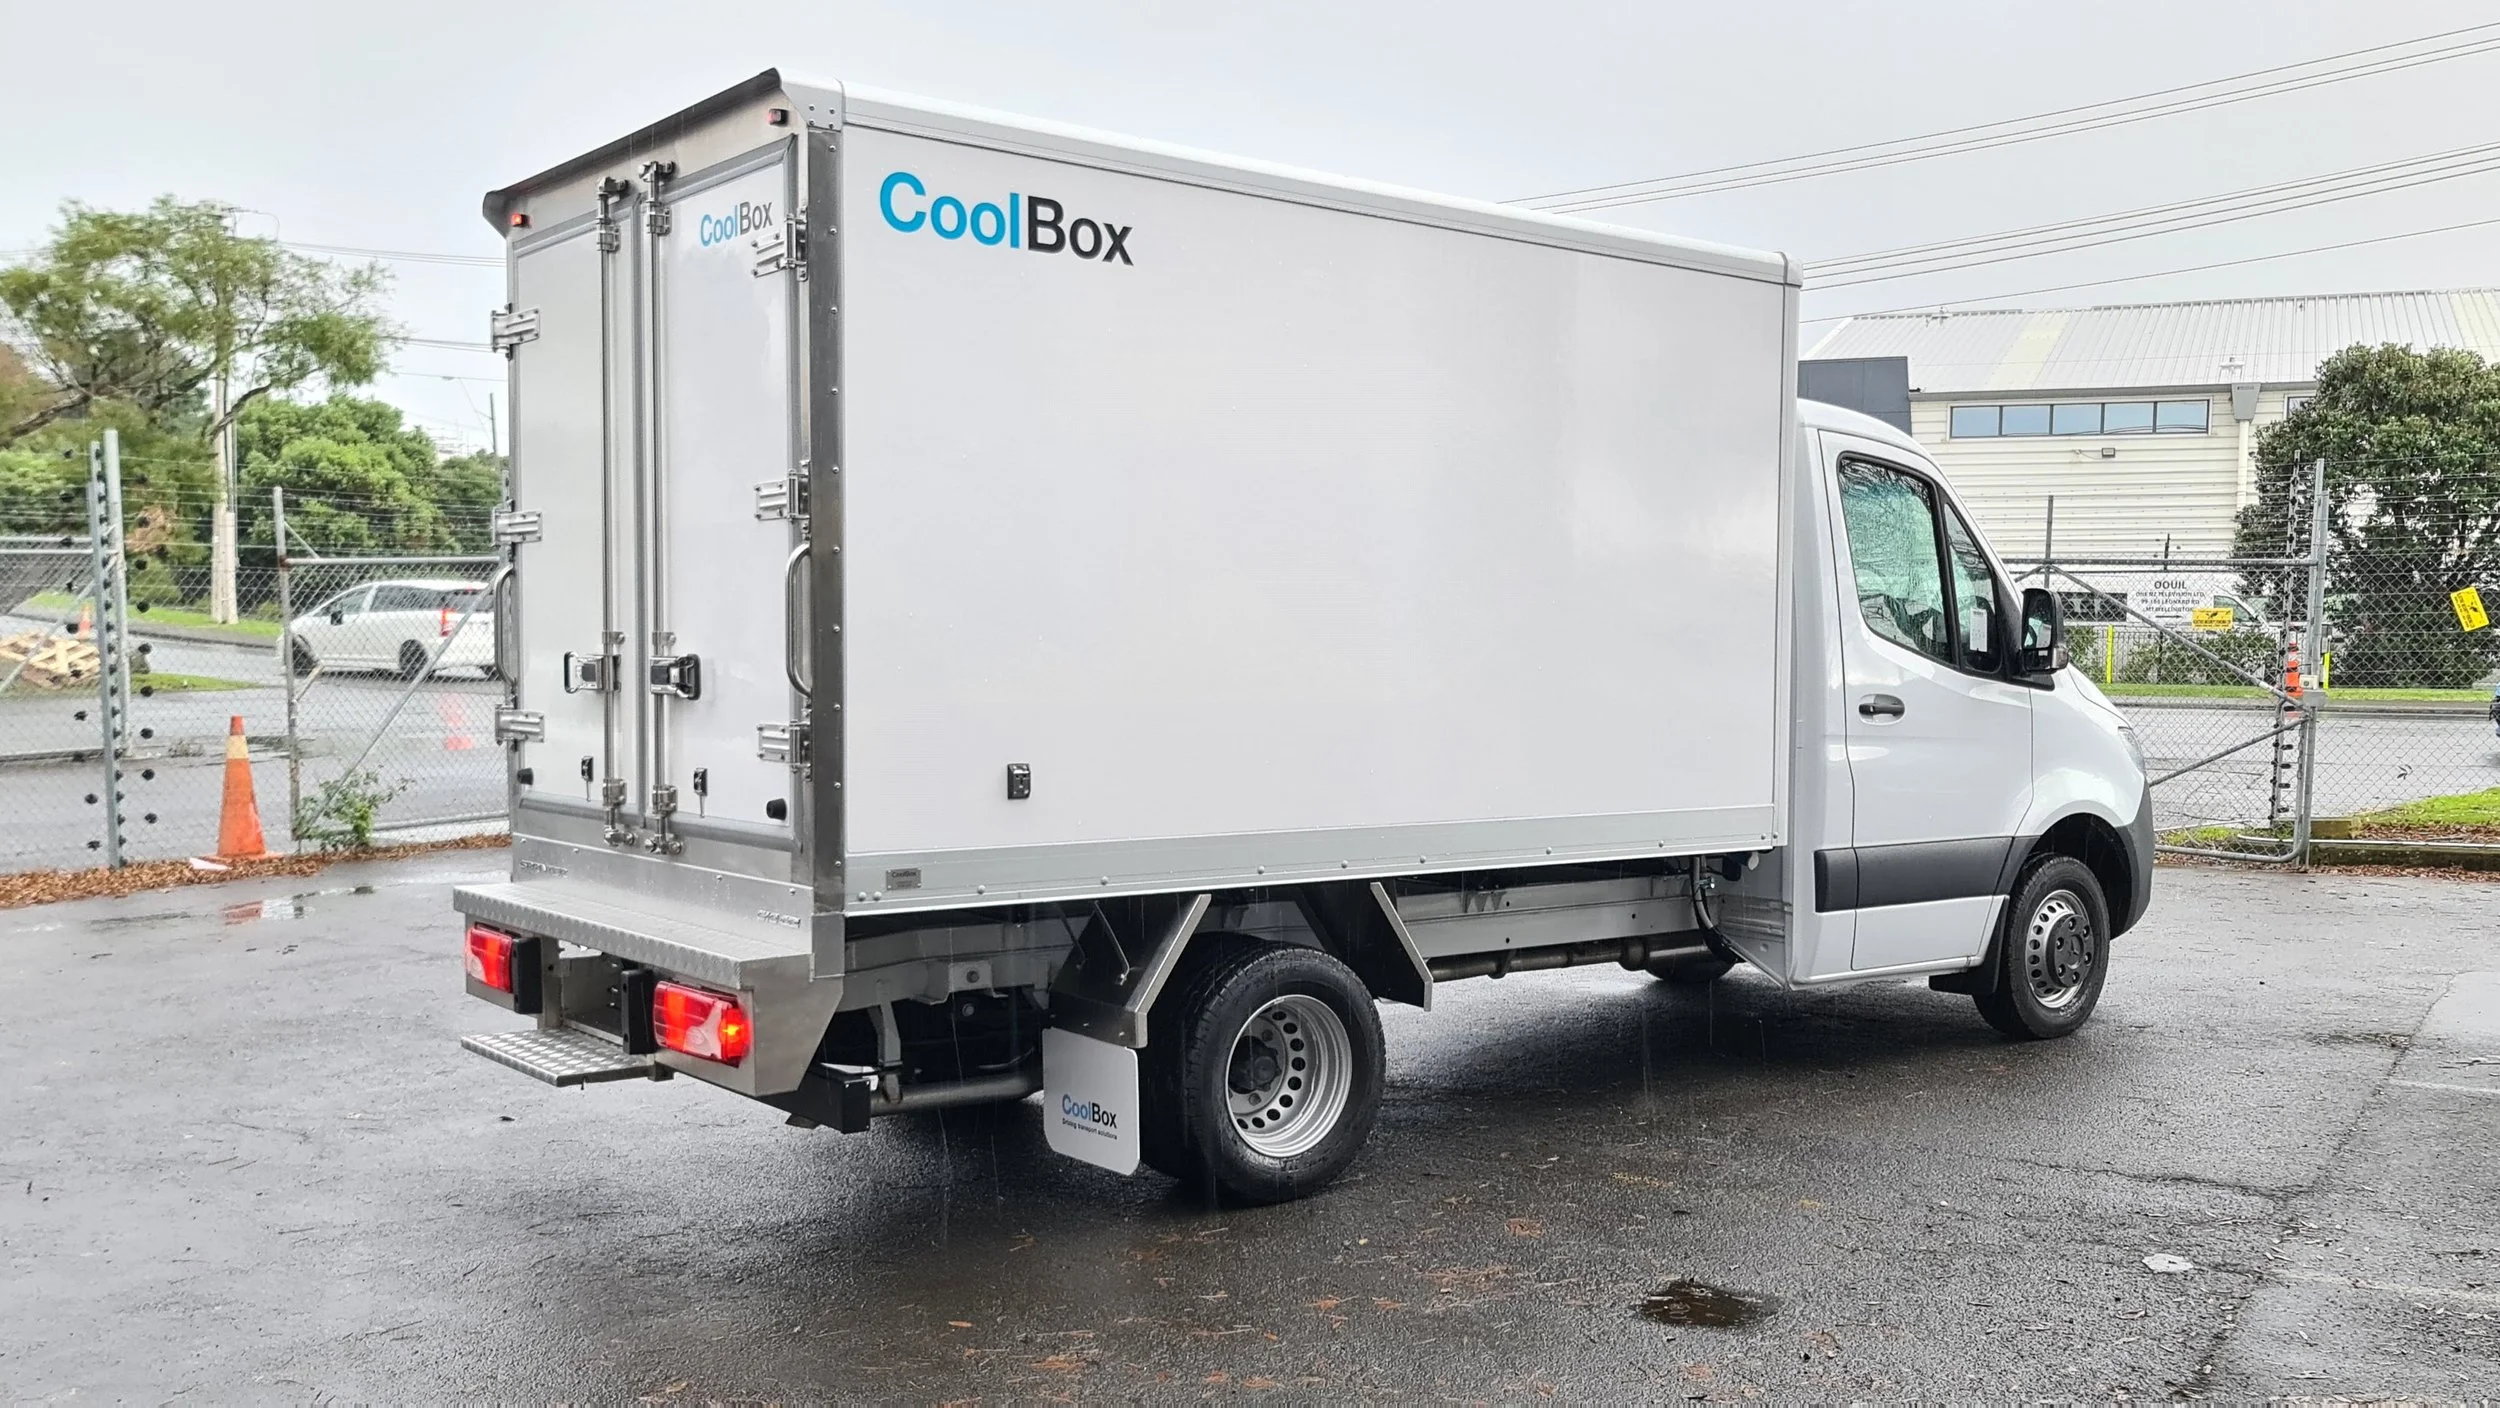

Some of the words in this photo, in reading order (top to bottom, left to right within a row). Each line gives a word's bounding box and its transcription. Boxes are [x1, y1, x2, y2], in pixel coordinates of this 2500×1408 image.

[700, 201, 773, 247] CoolBox
[880, 171, 1134, 267] CoolBox
[1062, 1093, 1117, 1129] CoolBox
